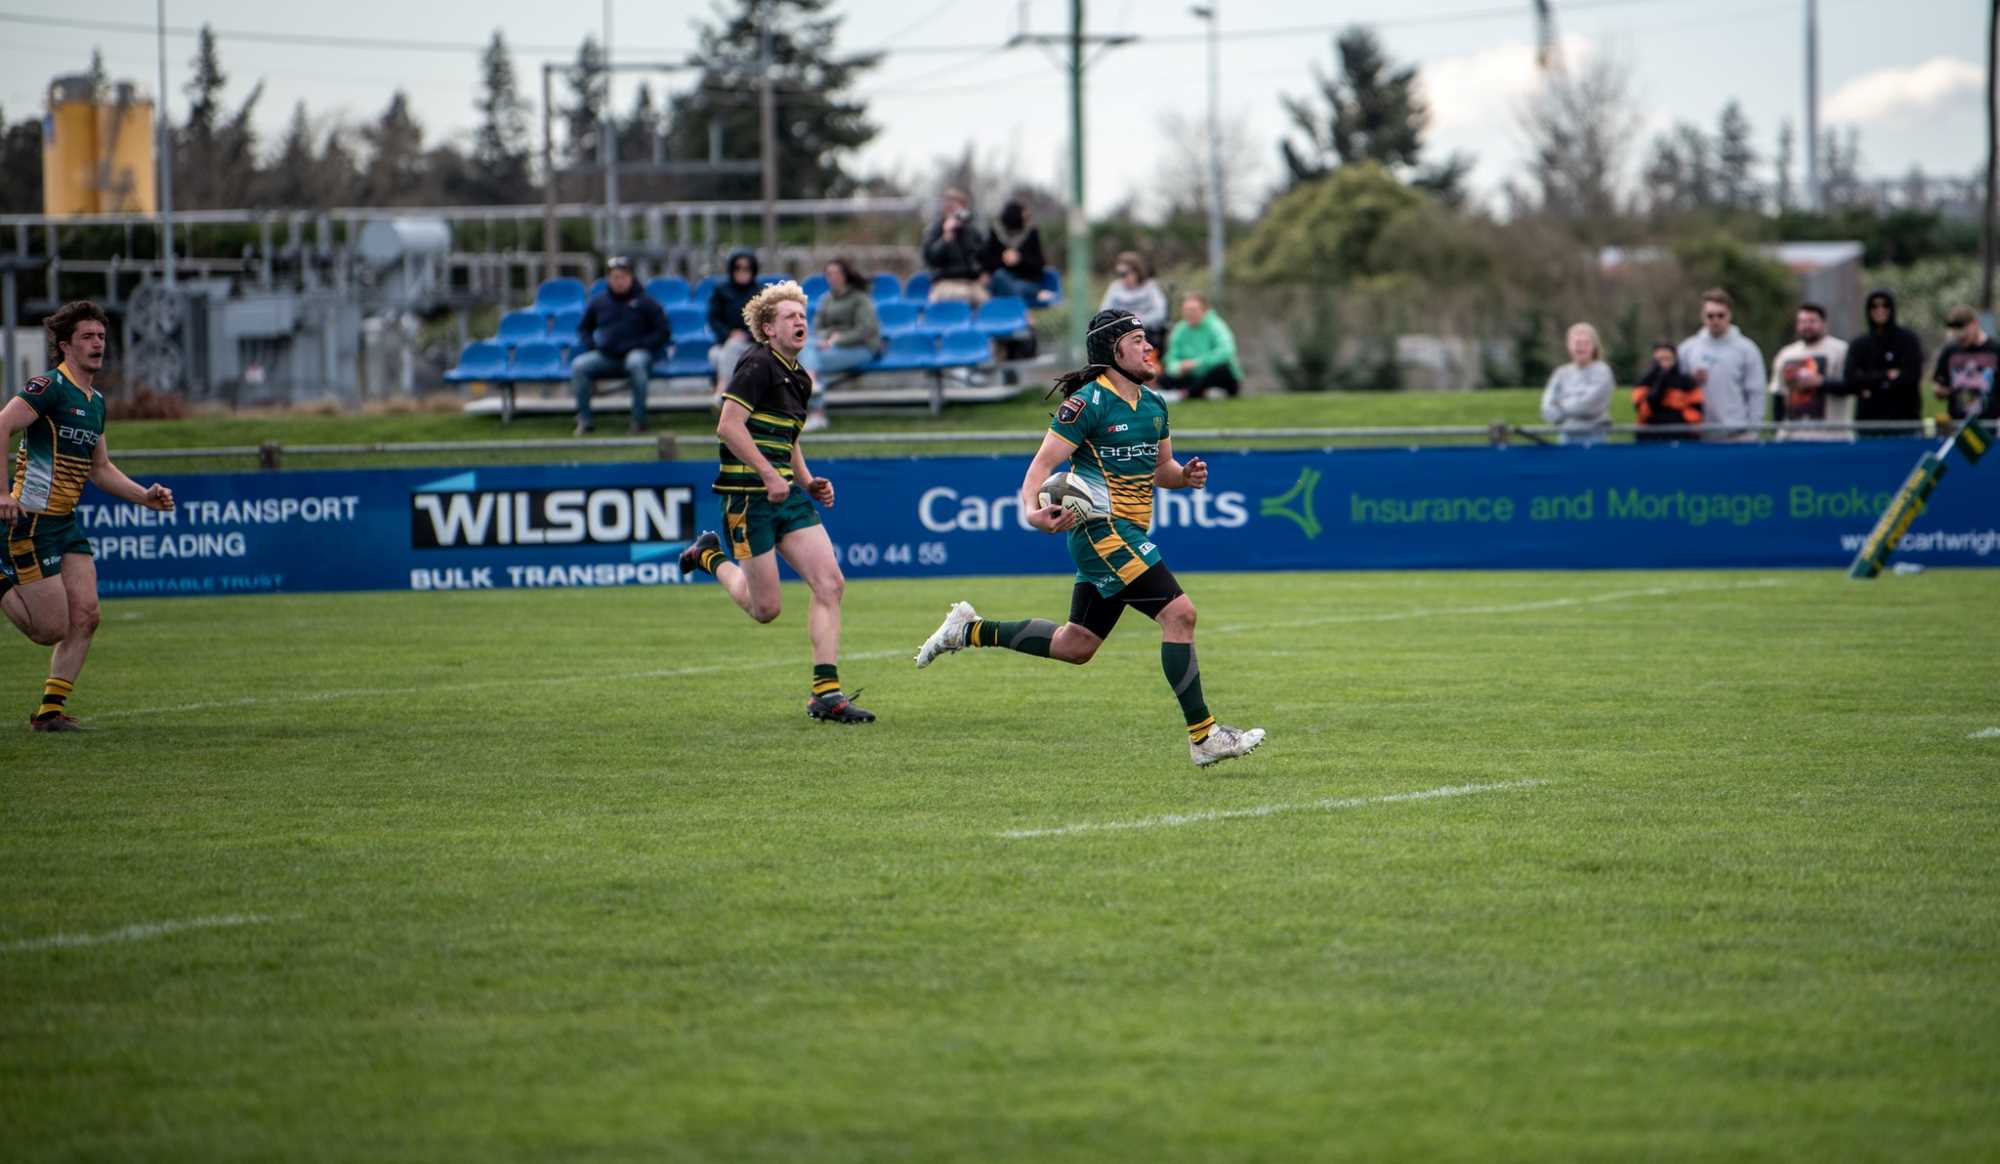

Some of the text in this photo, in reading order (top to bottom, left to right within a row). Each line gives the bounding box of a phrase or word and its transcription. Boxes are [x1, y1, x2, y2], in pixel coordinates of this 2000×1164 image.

[78, 496, 359, 528] TAINER TRANSPORT
[414, 487, 692, 547] WILSON
[1350, 483, 1928, 526] Insurance and Mortgage Broke
[88, 531, 246, 561] SPREADING
[220, 572, 285, 591] TRUST
[410, 566, 495, 591] BULK
